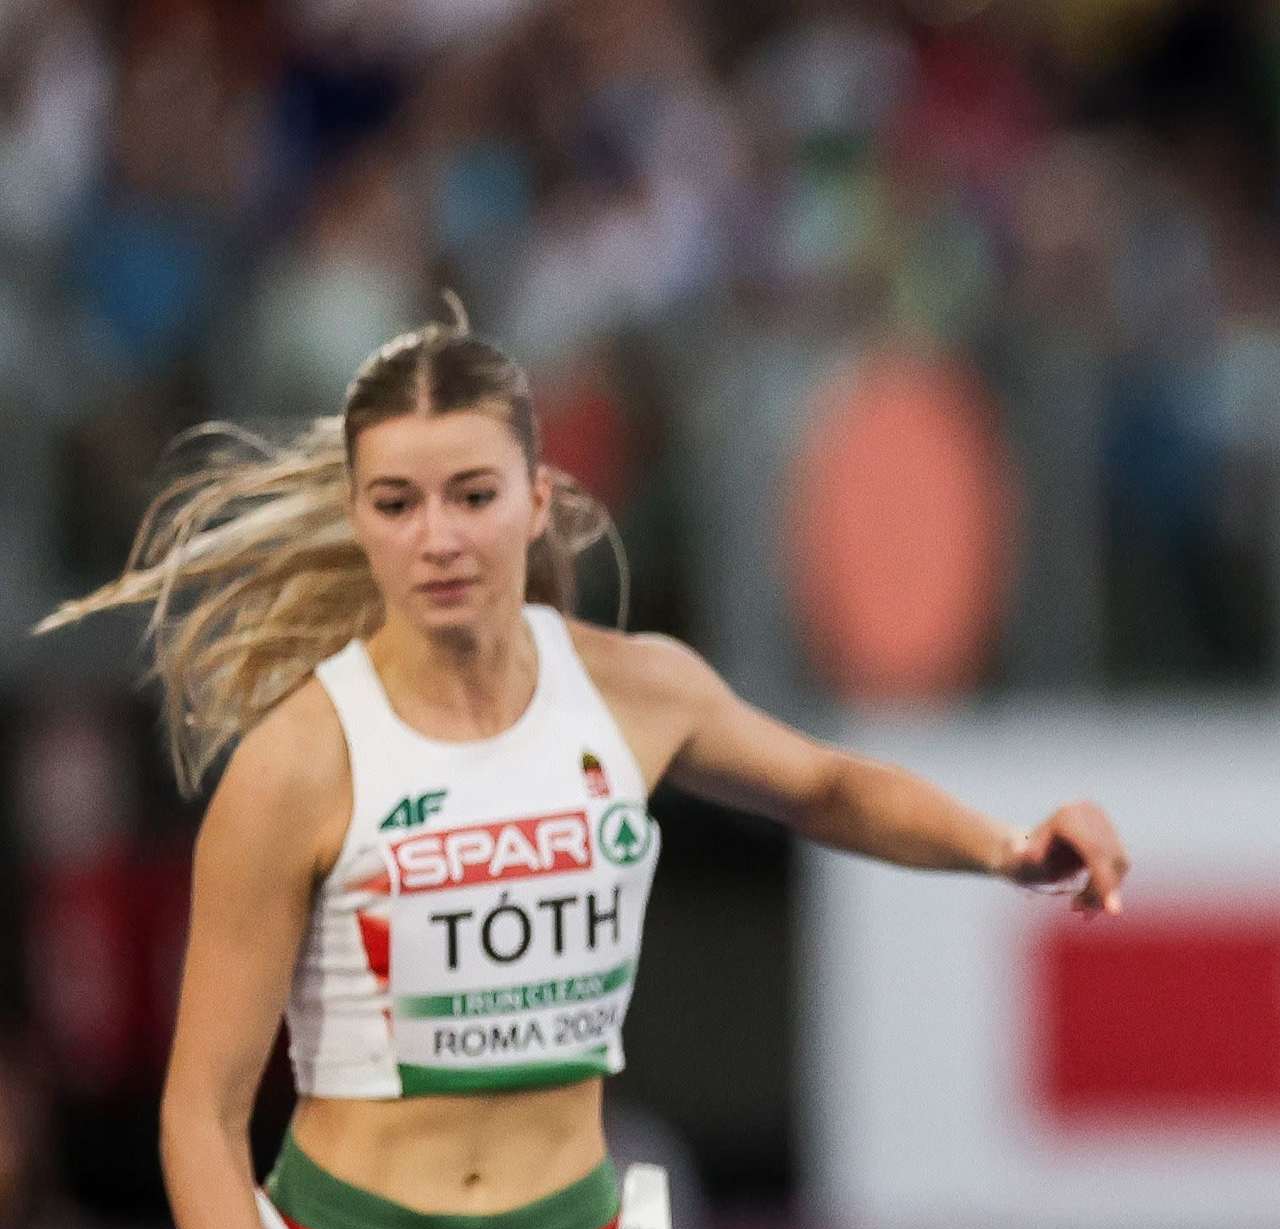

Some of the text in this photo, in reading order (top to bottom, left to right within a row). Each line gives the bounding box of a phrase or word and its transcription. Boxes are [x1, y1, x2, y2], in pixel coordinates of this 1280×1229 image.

[400, 817, 589, 889] SPAR
[430, 886, 621, 970] TÓTH
[433, 1020, 547, 1058] ROMA
